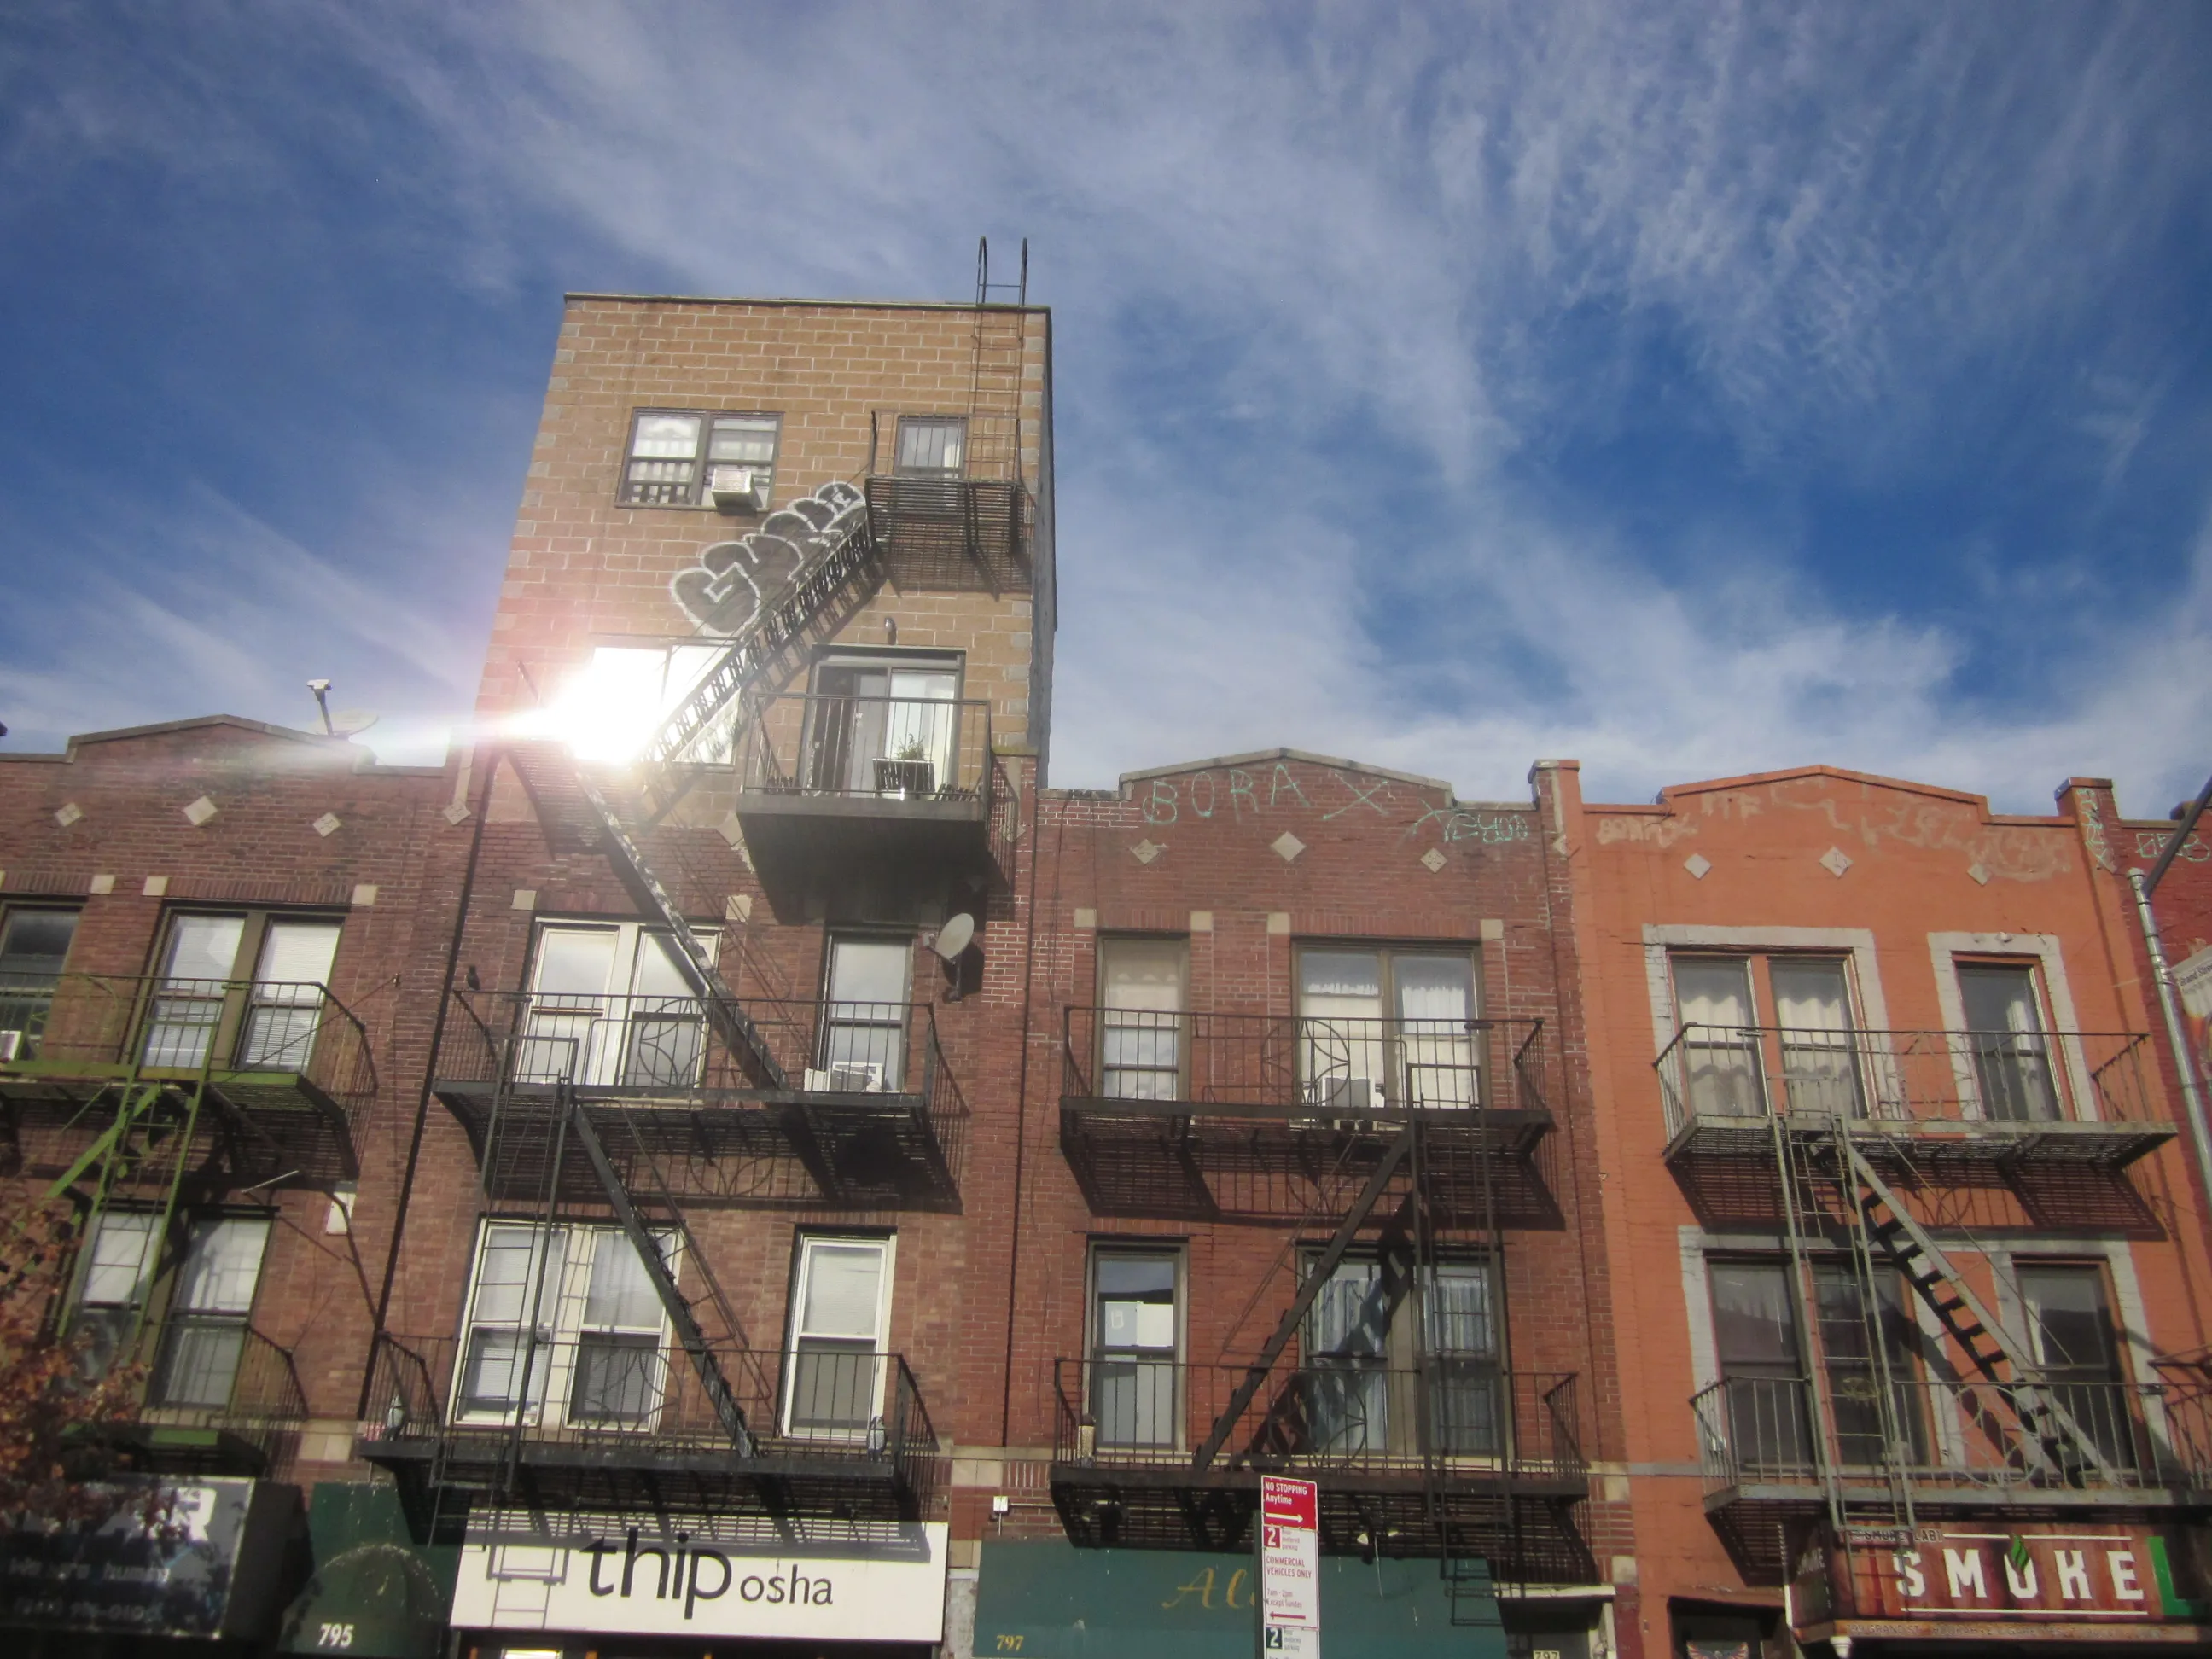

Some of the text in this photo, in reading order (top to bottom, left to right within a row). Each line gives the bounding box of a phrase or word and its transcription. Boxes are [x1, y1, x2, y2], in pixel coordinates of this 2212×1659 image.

[1265, 1481, 1307, 1495] NO STOPPING
[1266, 1493, 1293, 1505] Anytime
[1267, 1528, 1277, 1546] 2
[1266, 1555, 1305, 1567] COMMERCIAL
[579, 1527, 834, 1620] thip osha
[1266, 1566, 1312, 1579] VEHICLES ONLY
[317, 1623, 355, 1648] 795
[996, 1634, 1023, 1650] 797
[1270, 1627, 1279, 1647] 2
